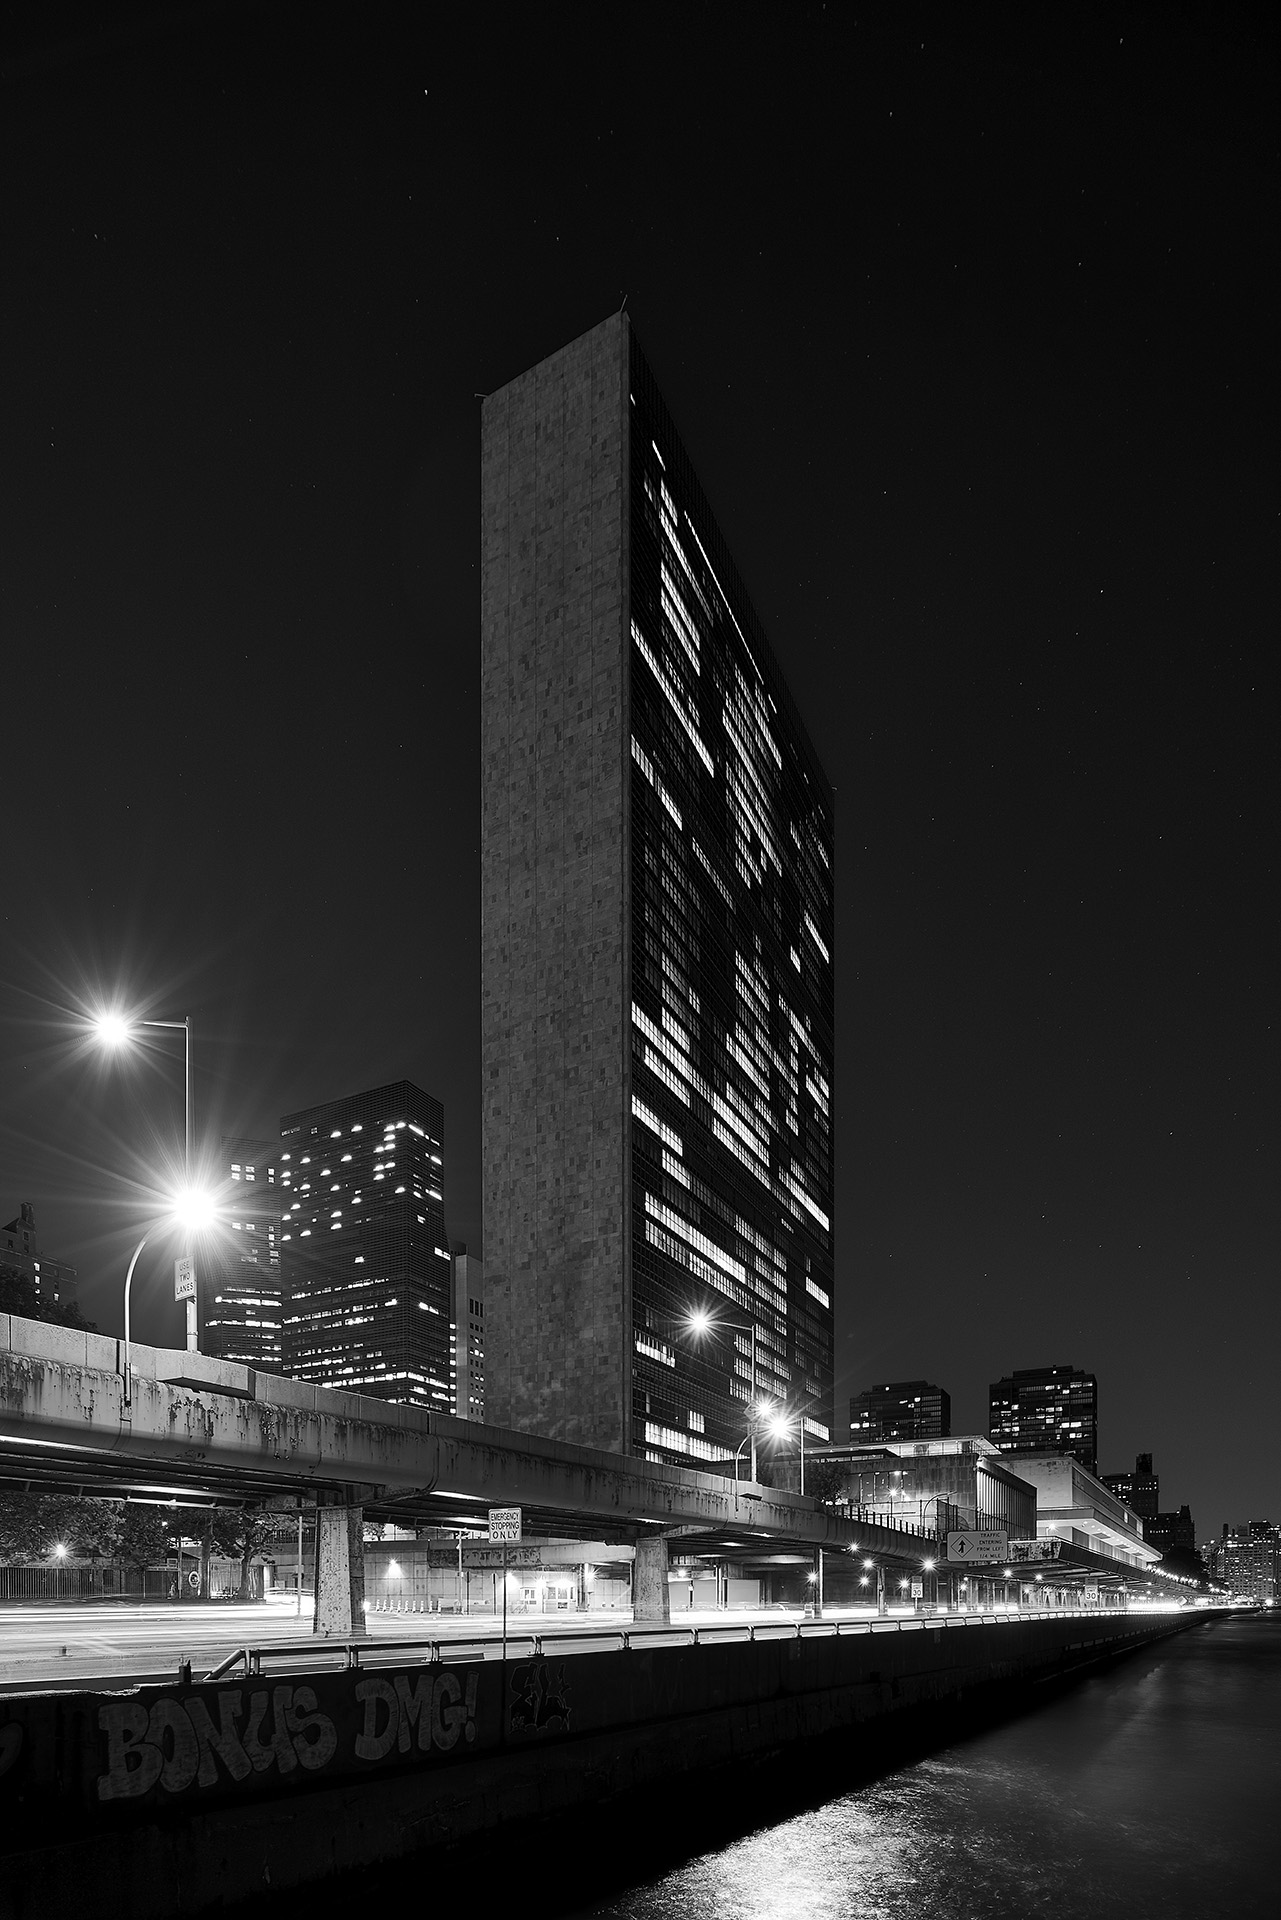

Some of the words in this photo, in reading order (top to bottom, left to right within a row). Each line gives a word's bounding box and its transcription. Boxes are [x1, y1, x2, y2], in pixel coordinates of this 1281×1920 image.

[179, 1260, 190, 1271] USE
[180, 1271, 191, 1282] TWO
[177, 1282, 193, 1294] LANES
[491, 1512, 519, 1521] EMERGENCY
[491, 1521, 519, 1530] STOPPING
[493, 1531, 517, 1539] ONLY
[97, 1685, 338, 1801] BONUS
[354, 1671, 480, 1761] DMG!
